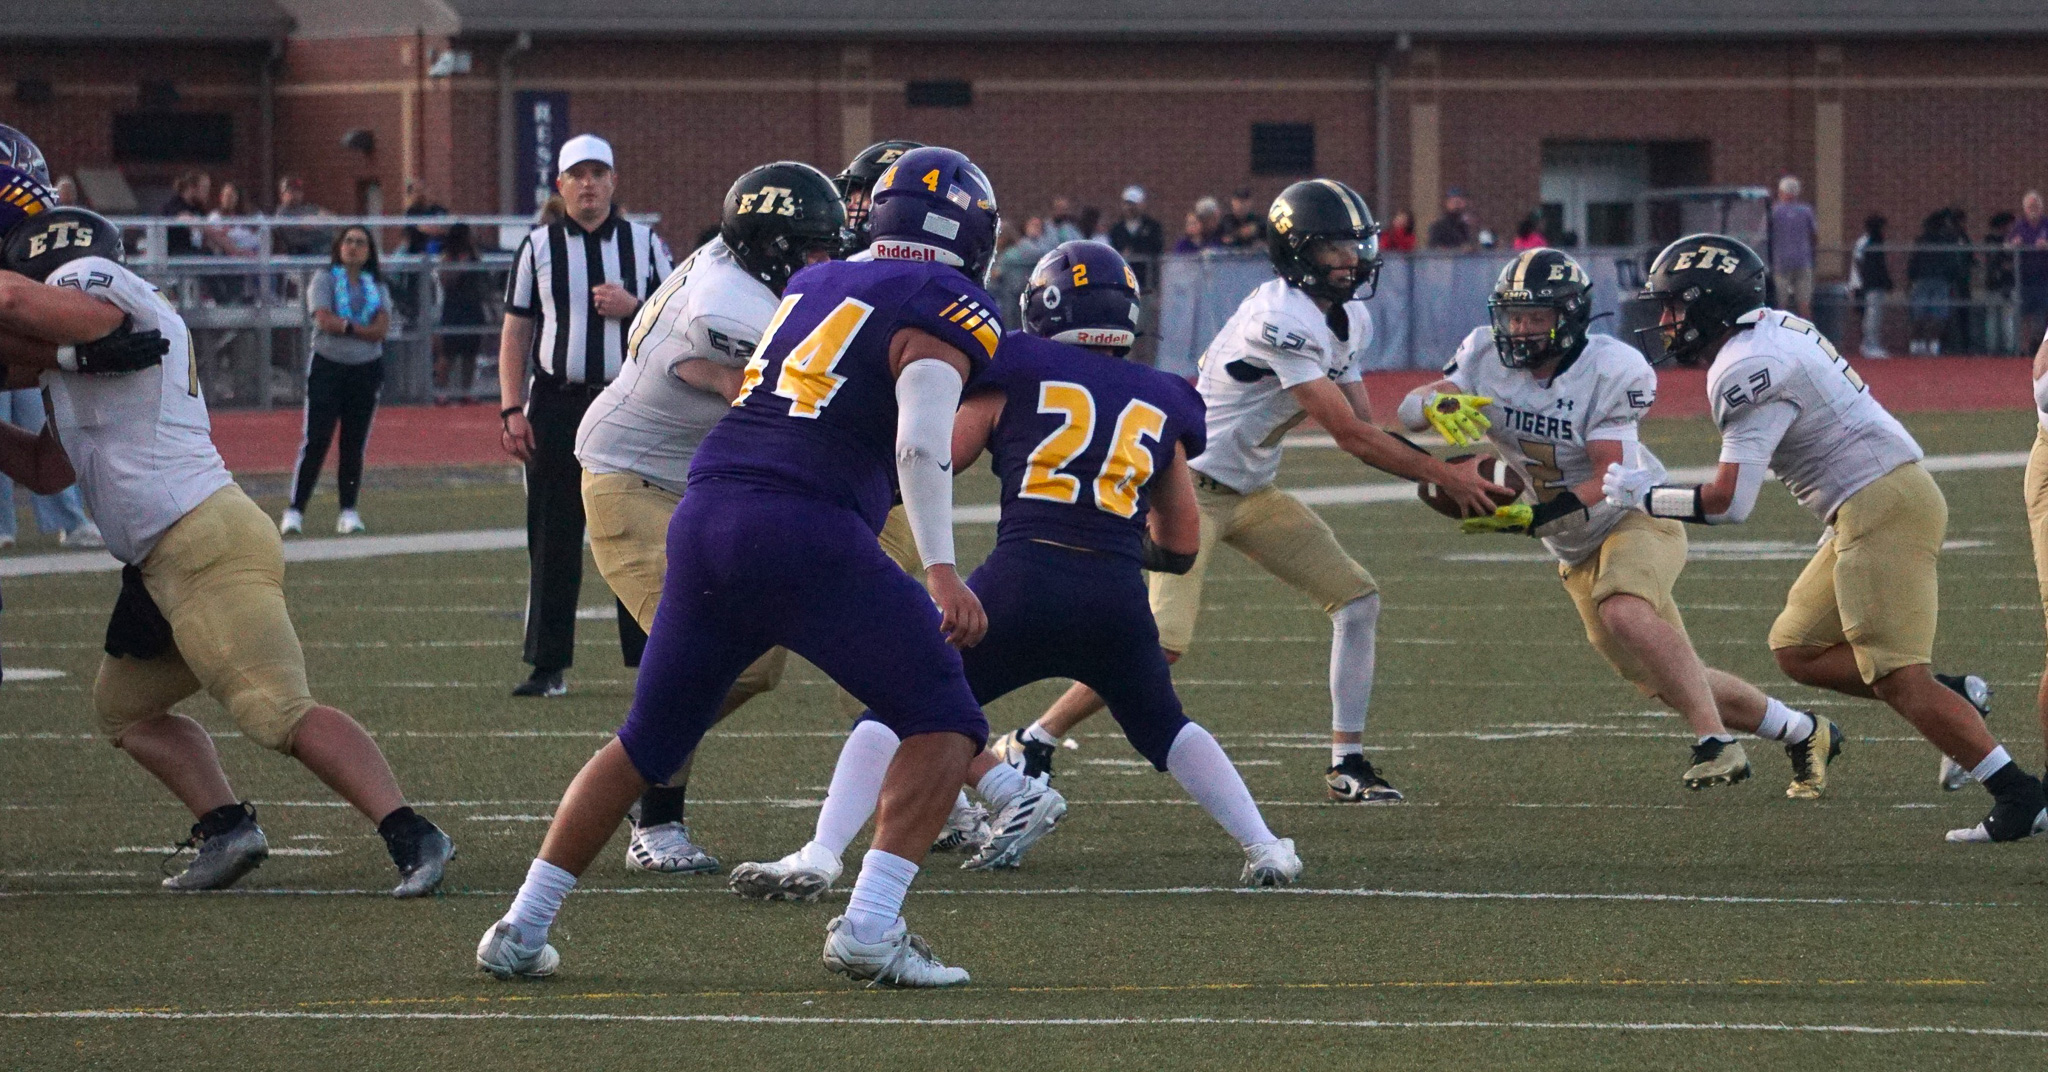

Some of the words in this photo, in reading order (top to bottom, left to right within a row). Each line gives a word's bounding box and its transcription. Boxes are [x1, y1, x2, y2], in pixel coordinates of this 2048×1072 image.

[738, 185, 795, 217] ETS
[28, 220, 94, 259] ETS
[877, 244, 936, 262] Riddell
[1673, 245, 1740, 275] ETS
[1077, 331, 1129, 346] Riddell
[1503, 406, 1573, 440] TIGERS
[1017, 380, 1168, 519] 26
